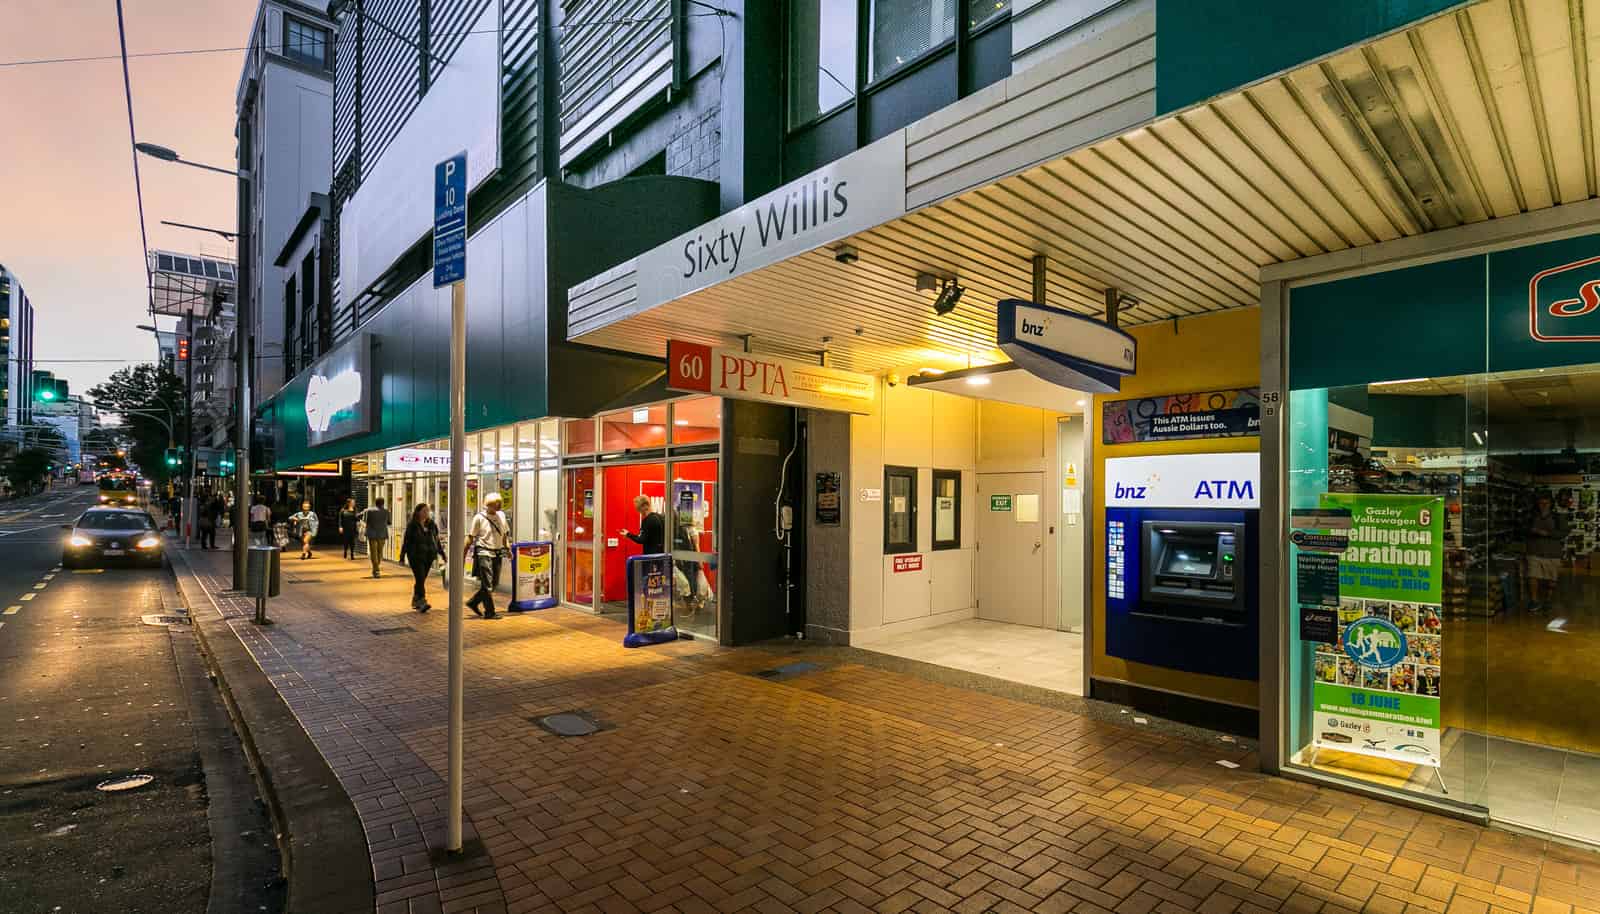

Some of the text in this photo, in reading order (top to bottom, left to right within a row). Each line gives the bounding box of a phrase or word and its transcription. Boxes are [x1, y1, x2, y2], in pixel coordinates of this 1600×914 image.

[445, 160, 456, 185] P
[446, 187, 456, 208] 10
[683, 176, 848, 279] Sixty Willis
[1021, 318, 1044, 337] bnz
[679, 352, 704, 381] 60
[719, 354, 789, 398] PPTA
[1263, 392, 1279, 404] 58
[1152, 413, 1216, 425] This ATM issues
[1152, 422, 1228, 433] Aussie Dollars too.
[1247, 416, 1261, 428] bn
[1114, 479, 1255, 500] bnz ATM
[1353, 515, 1416, 527] Volkswagen
[1365, 506, 1403, 518] Gazley
[1331, 546, 1432, 566] arathon
[1351, 692, 1400, 710] 18 JUNE
